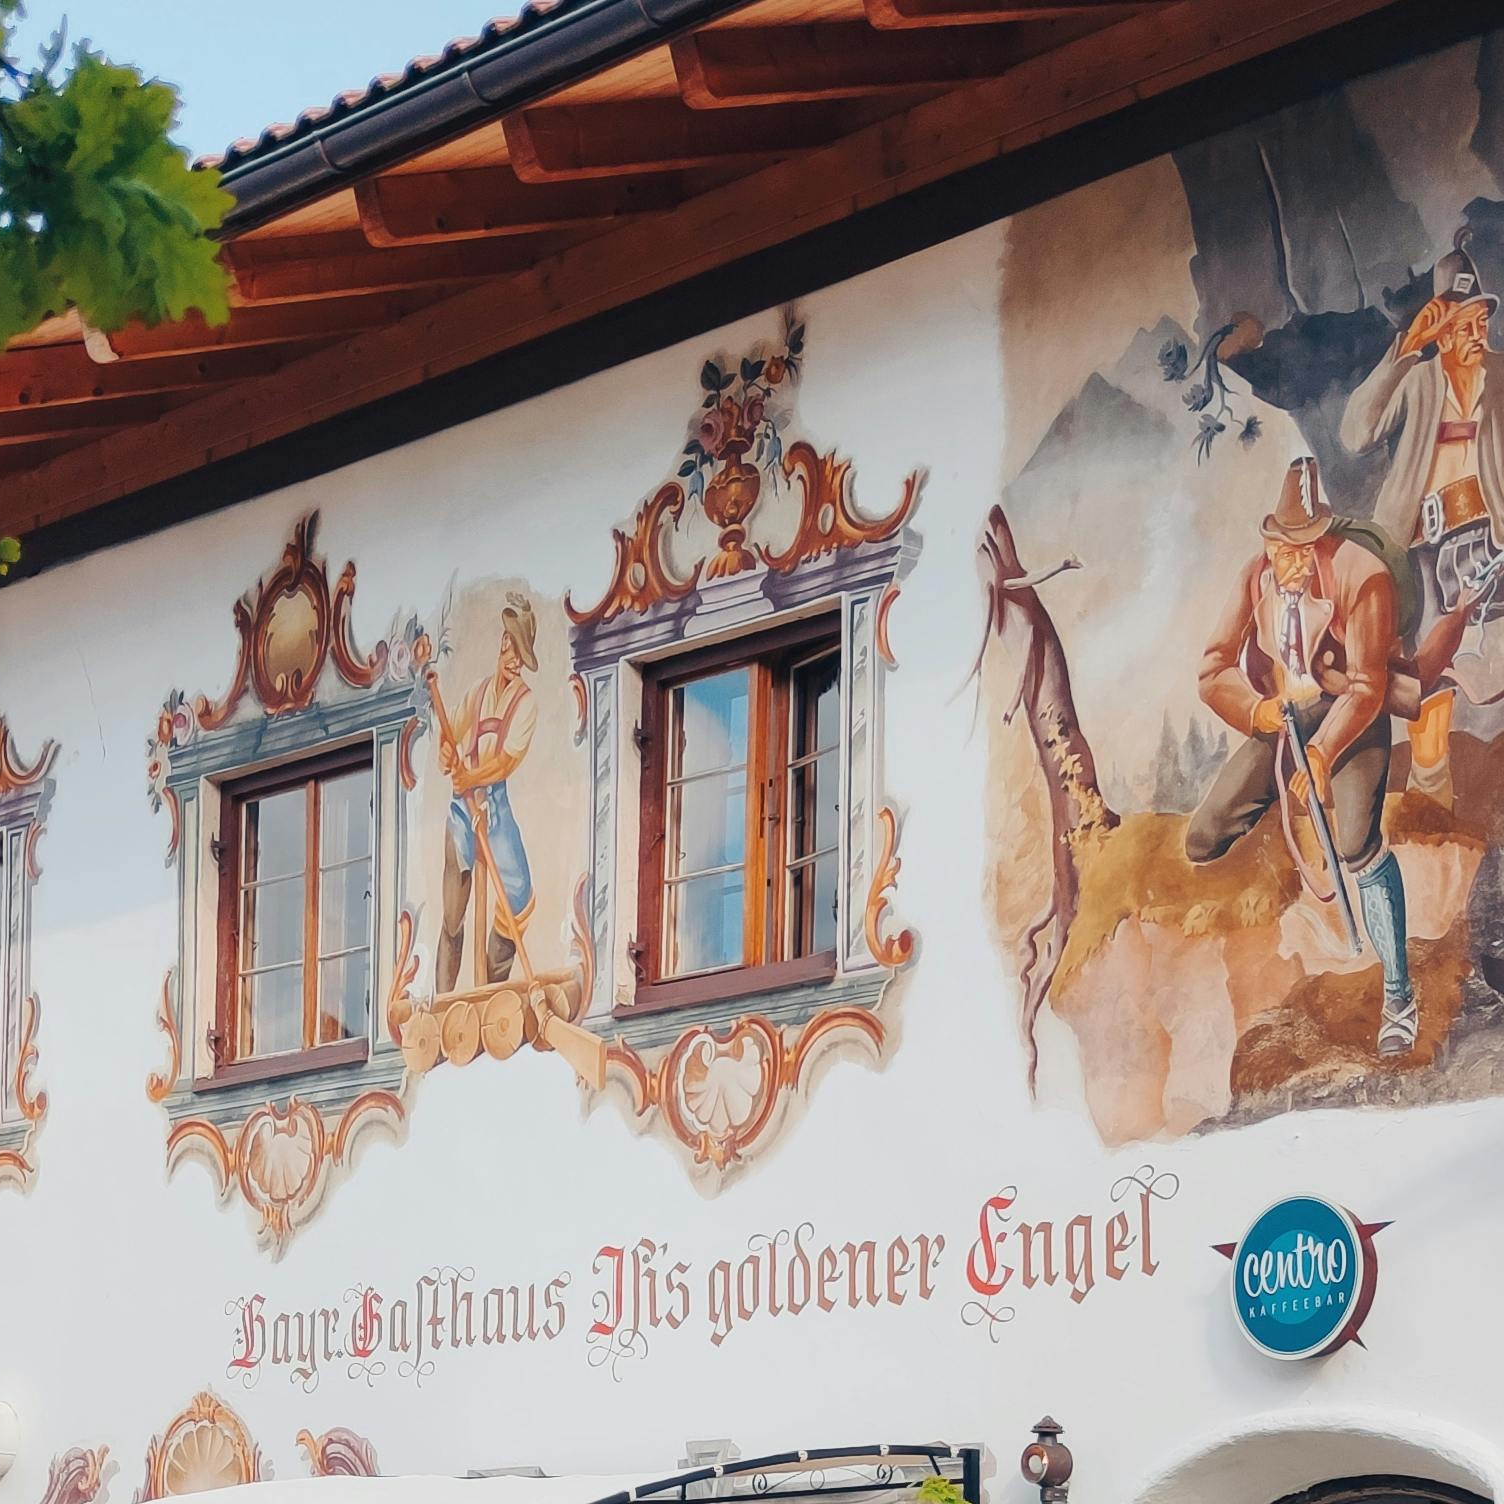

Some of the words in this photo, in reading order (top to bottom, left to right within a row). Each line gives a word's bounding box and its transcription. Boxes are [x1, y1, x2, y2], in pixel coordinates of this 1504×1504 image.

[708, 1222, 946, 1346] goldener
[960, 1163, 1179, 1343] Engel
[1243, 1233, 1347, 1298] centro
[1249, 1291, 1345, 1319] KAFFEEBAR
